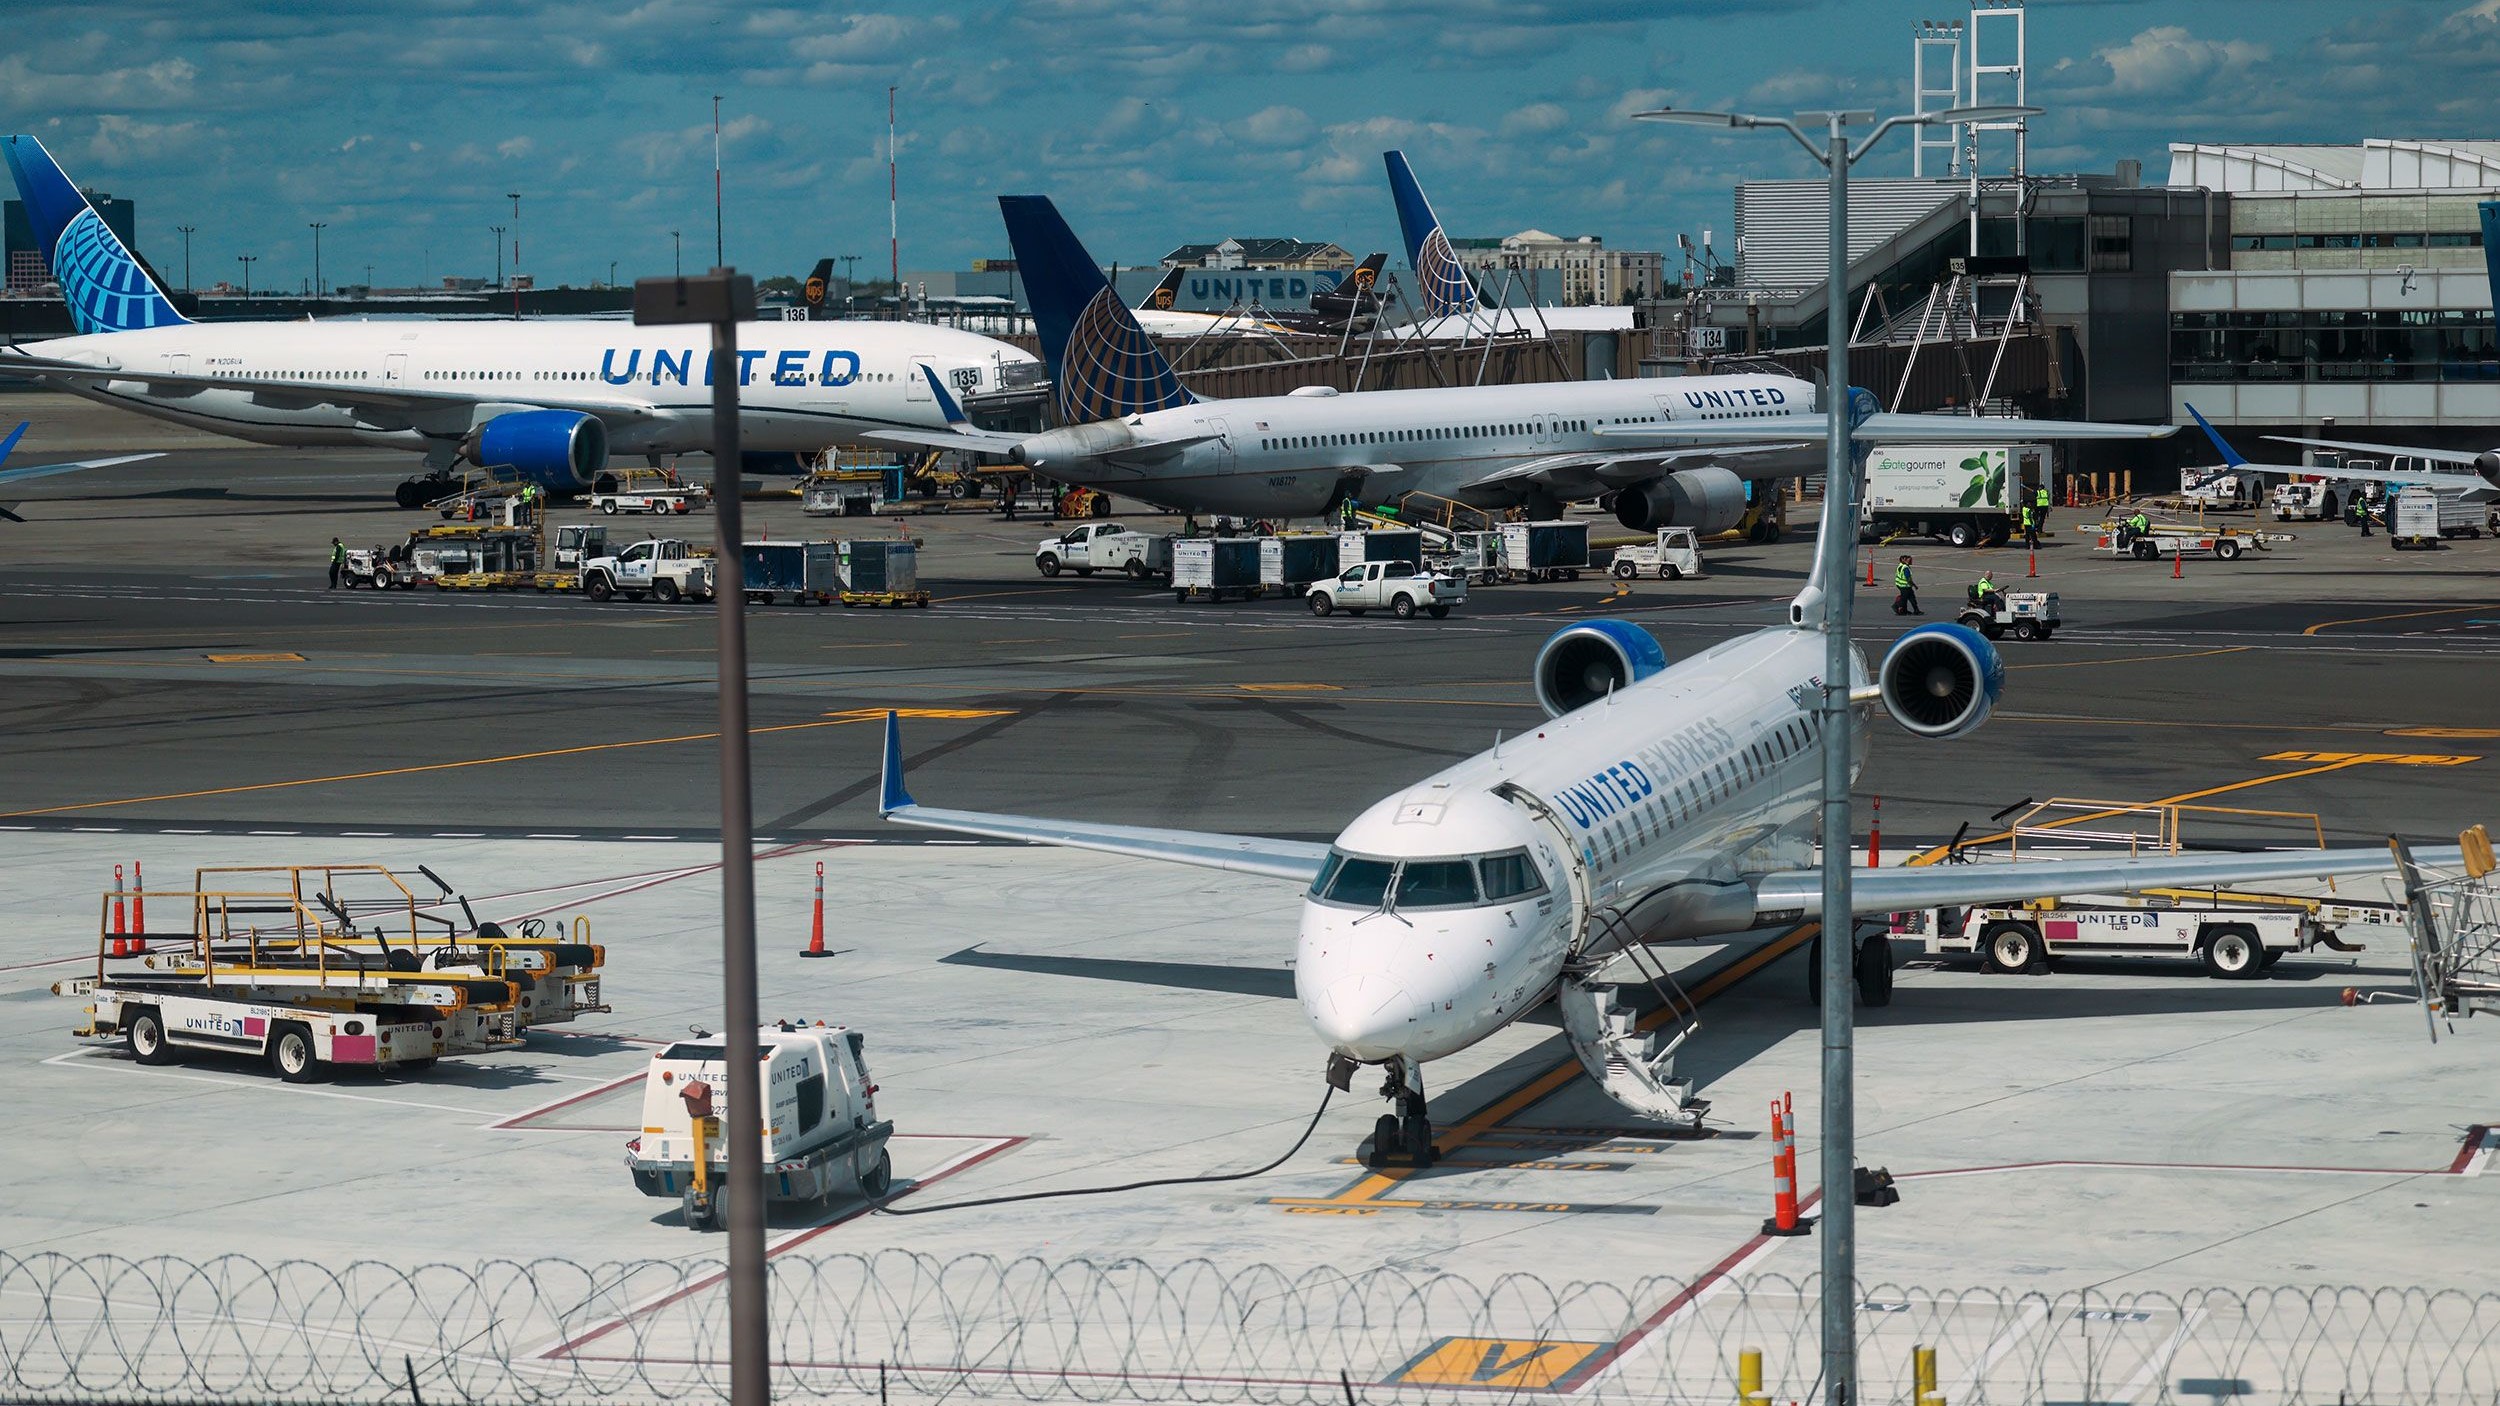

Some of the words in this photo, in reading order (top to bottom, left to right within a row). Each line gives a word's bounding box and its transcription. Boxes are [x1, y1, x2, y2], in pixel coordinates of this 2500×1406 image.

[1951, 262, 1965, 271] 135
[1191, 278, 1307, 299] UNITED
[786, 308, 805, 321] 136
[1702, 330, 1722, 347] 134
[600, 348, 861, 387] UNITED
[953, 369, 978, 386] 135
[1683, 388, 1786, 408] UNITED
[1553, 760, 1653, 829] UNITED
[1636, 716, 1735, 787] EXPRESS
[2076, 914, 2142, 924] UNITED
[186, 1018, 231, 1032] UNITED
[387, 1025, 424, 1034] UNITED
[771, 1064, 802, 1085] UNITED
[1471, 1343, 1560, 1381] V
